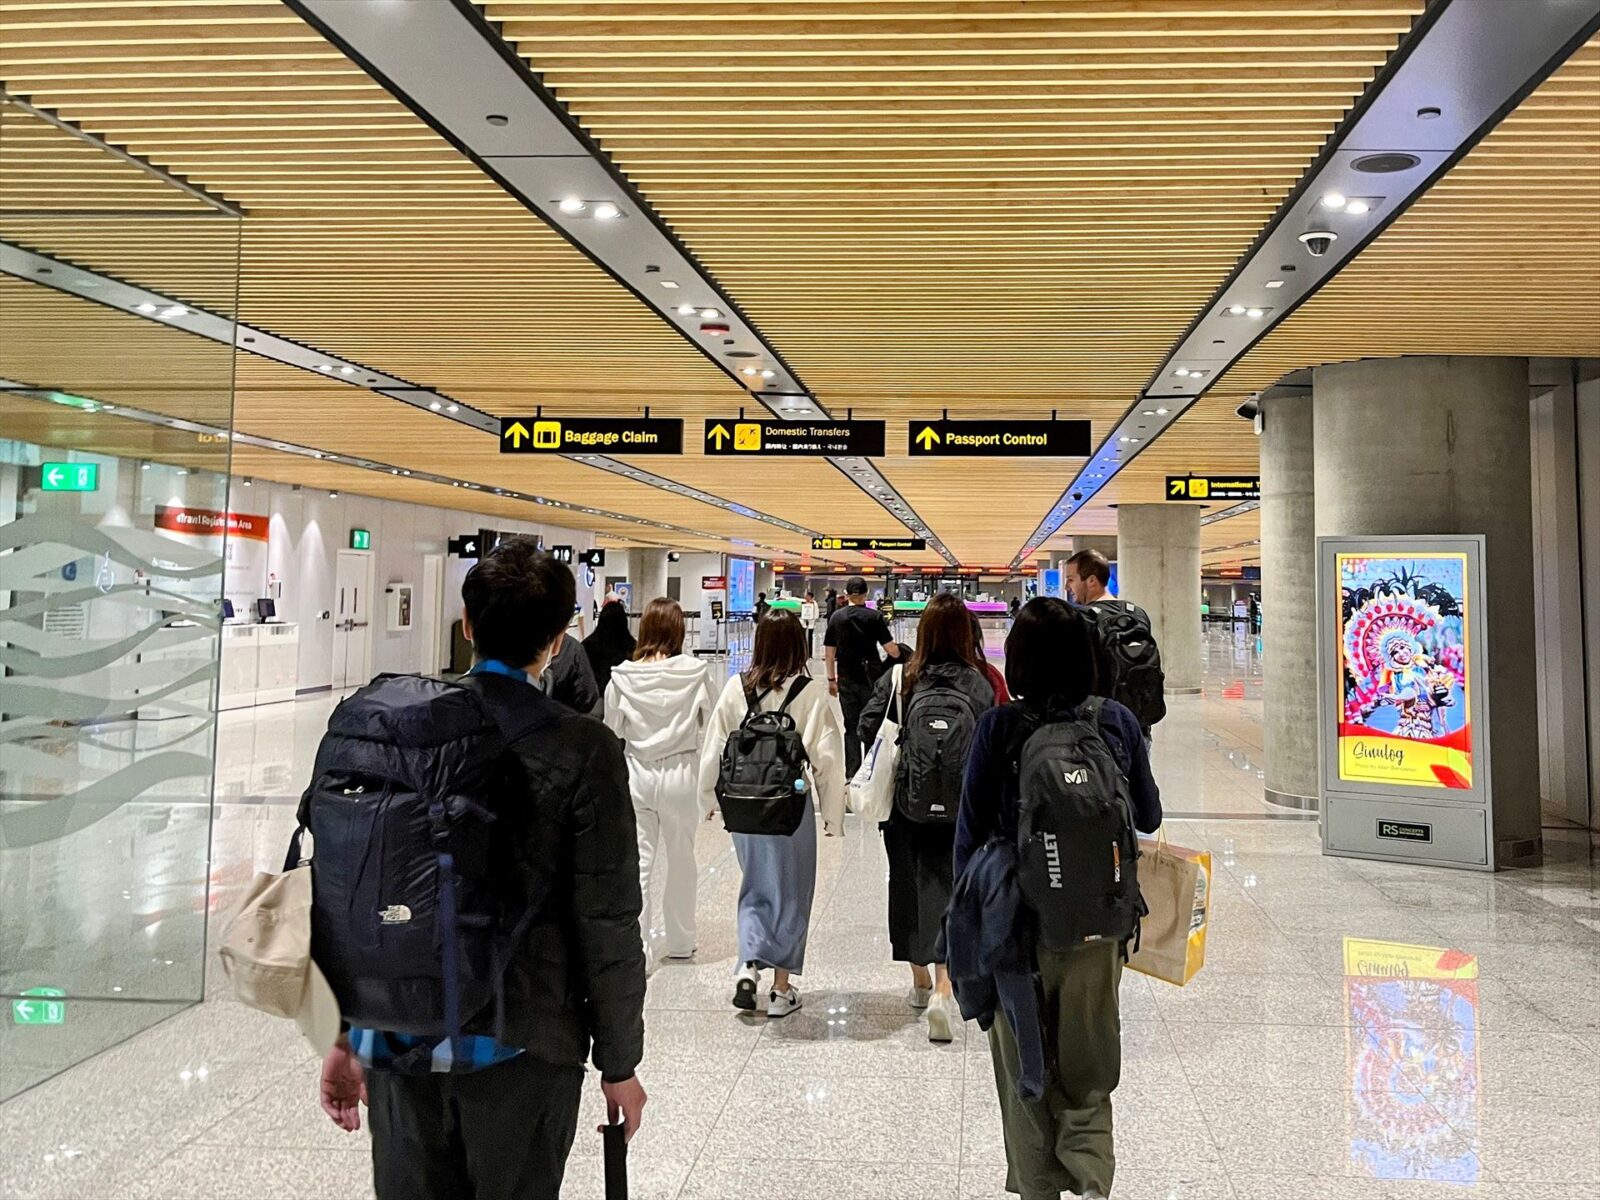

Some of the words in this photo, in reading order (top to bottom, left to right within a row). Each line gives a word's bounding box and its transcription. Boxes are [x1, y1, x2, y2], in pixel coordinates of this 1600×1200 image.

[565, 431, 619, 446] Baggage
[622, 431, 658, 444] Claim
[765, 426, 808, 436] Domestic
[809, 427, 850, 437] Transfers
[946, 433, 1000, 447] Passport
[1003, 433, 1047, 445] Control
[238, 519, 252, 530] Area
[1353, 741, 1404, 766] Sinulog
[1382, 824, 1399, 835] RS
[1044, 832, 1063, 888] MILLET
